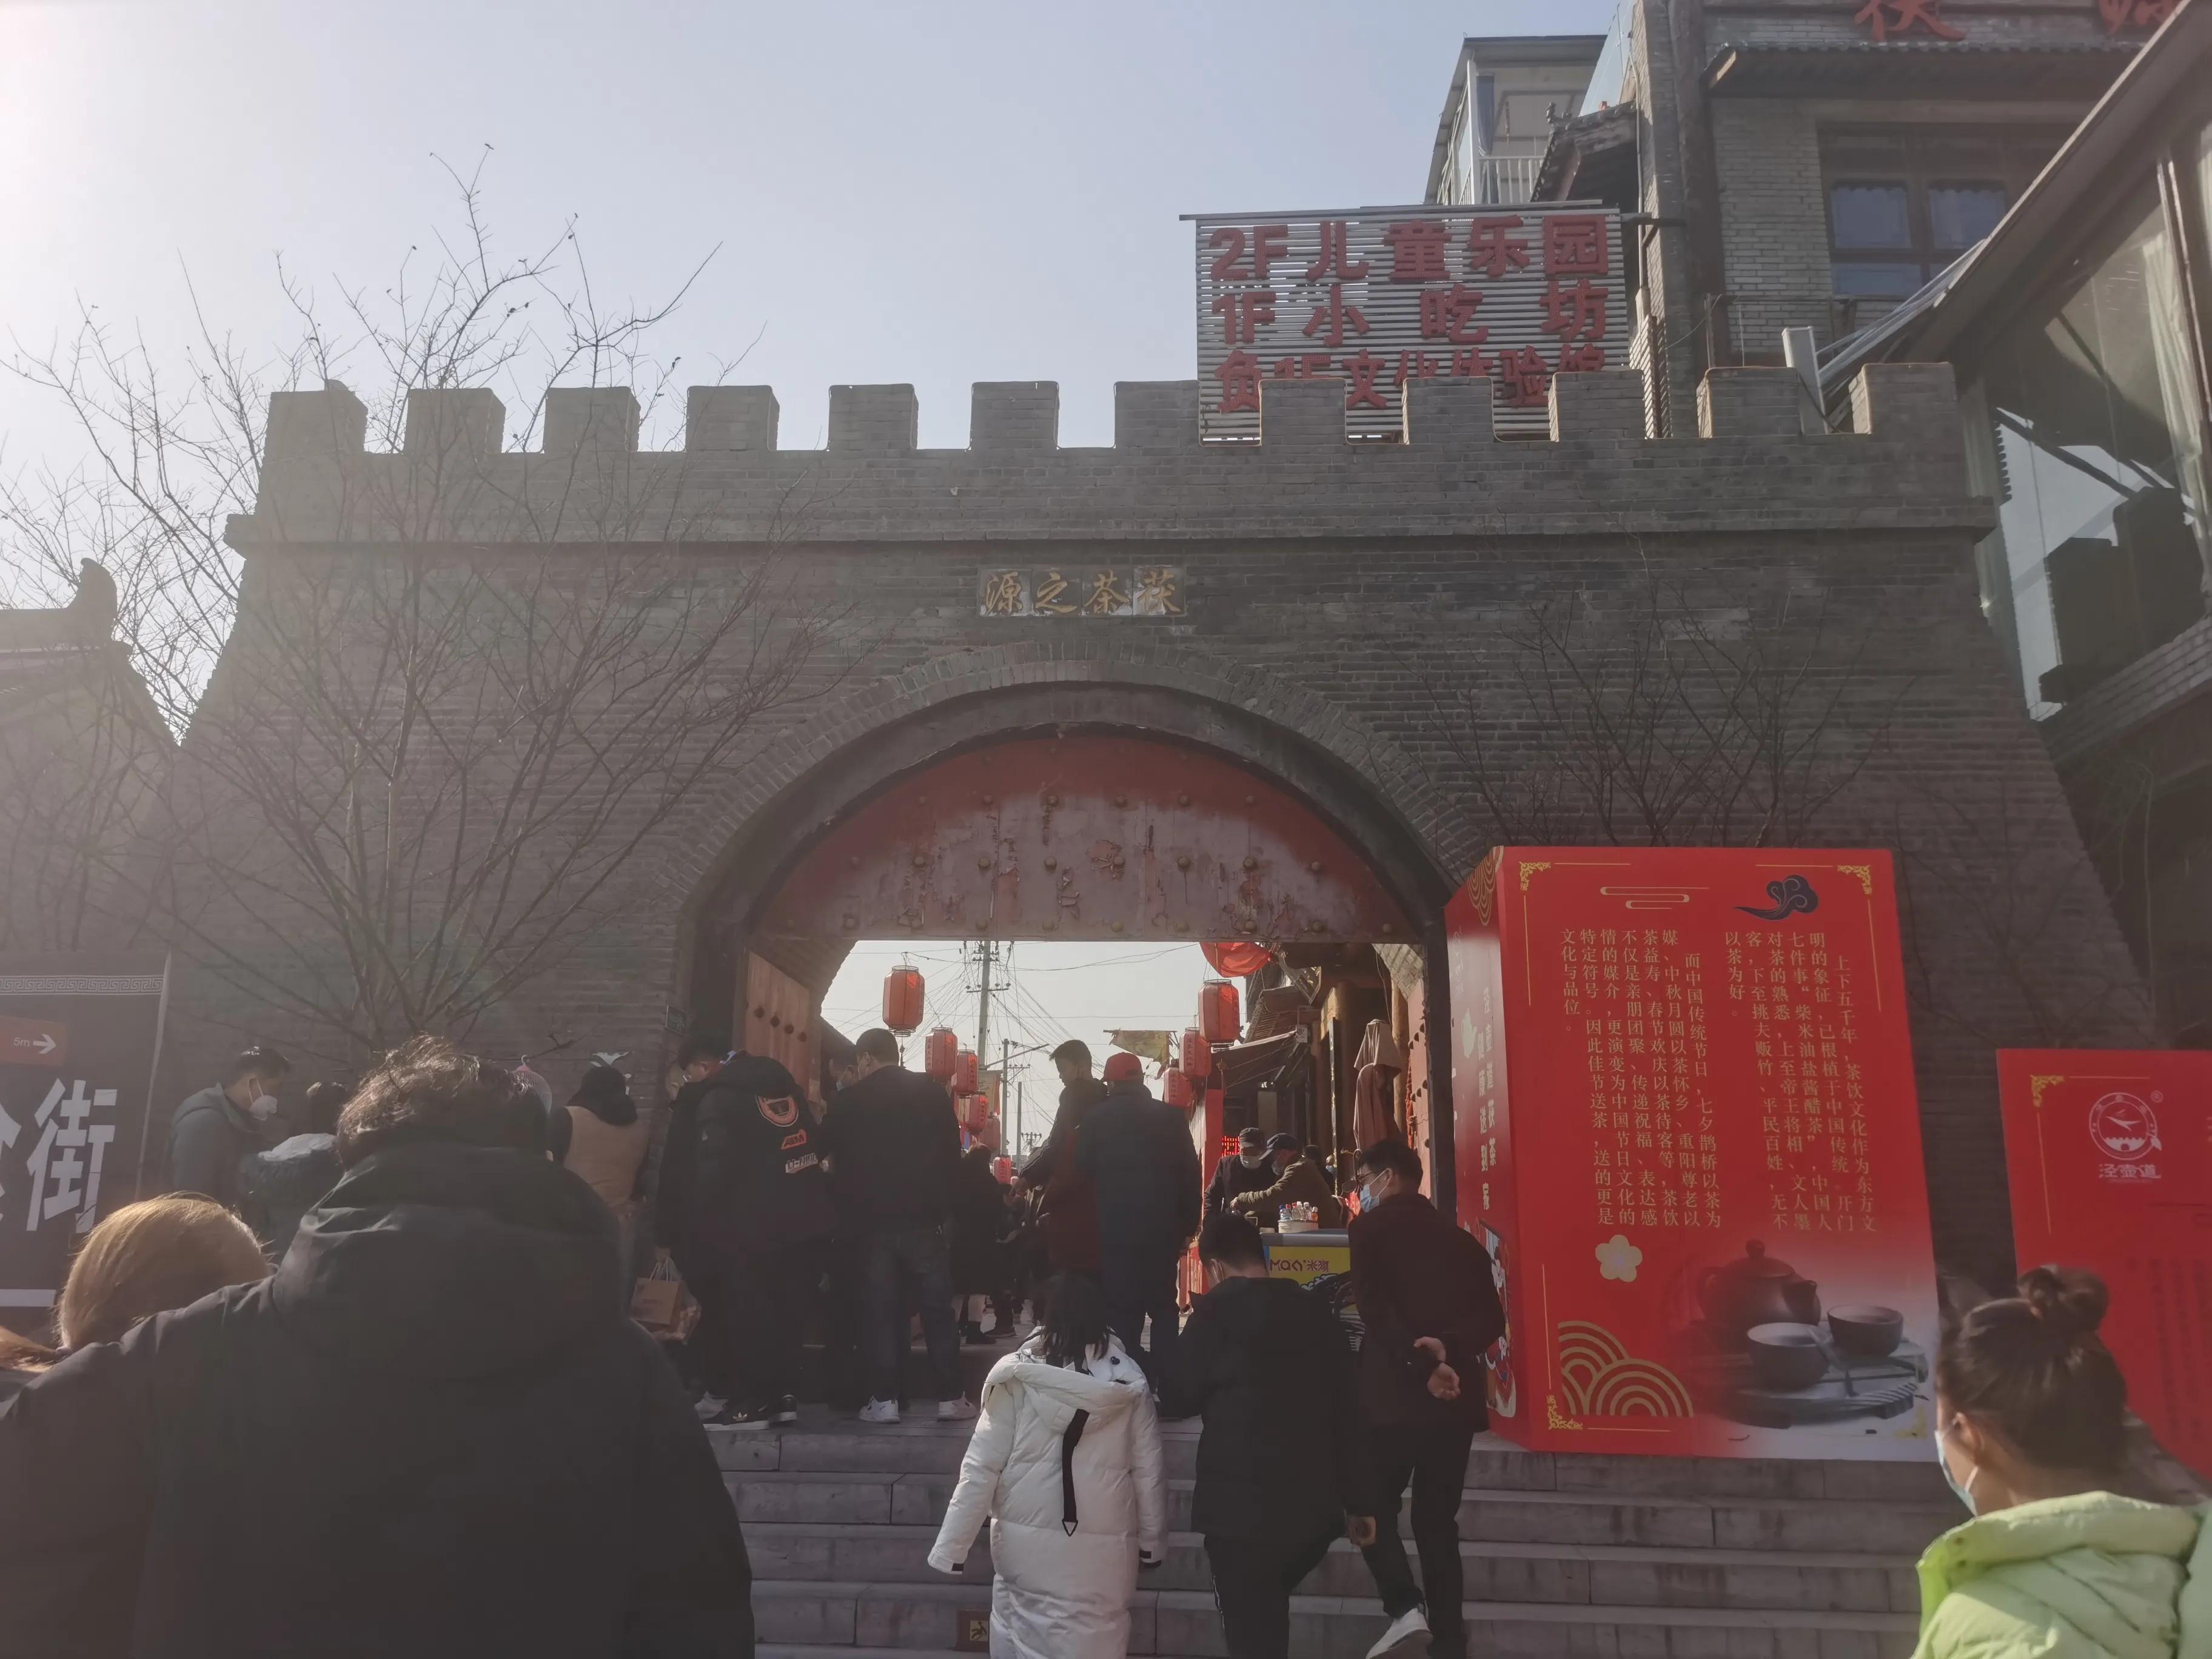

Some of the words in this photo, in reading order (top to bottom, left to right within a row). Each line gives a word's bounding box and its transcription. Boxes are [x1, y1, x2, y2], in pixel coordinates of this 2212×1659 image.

[1208, 213, 1609, 282] 2F儿童乐园
[1211, 278, 1607, 347] 1F小吃坊
